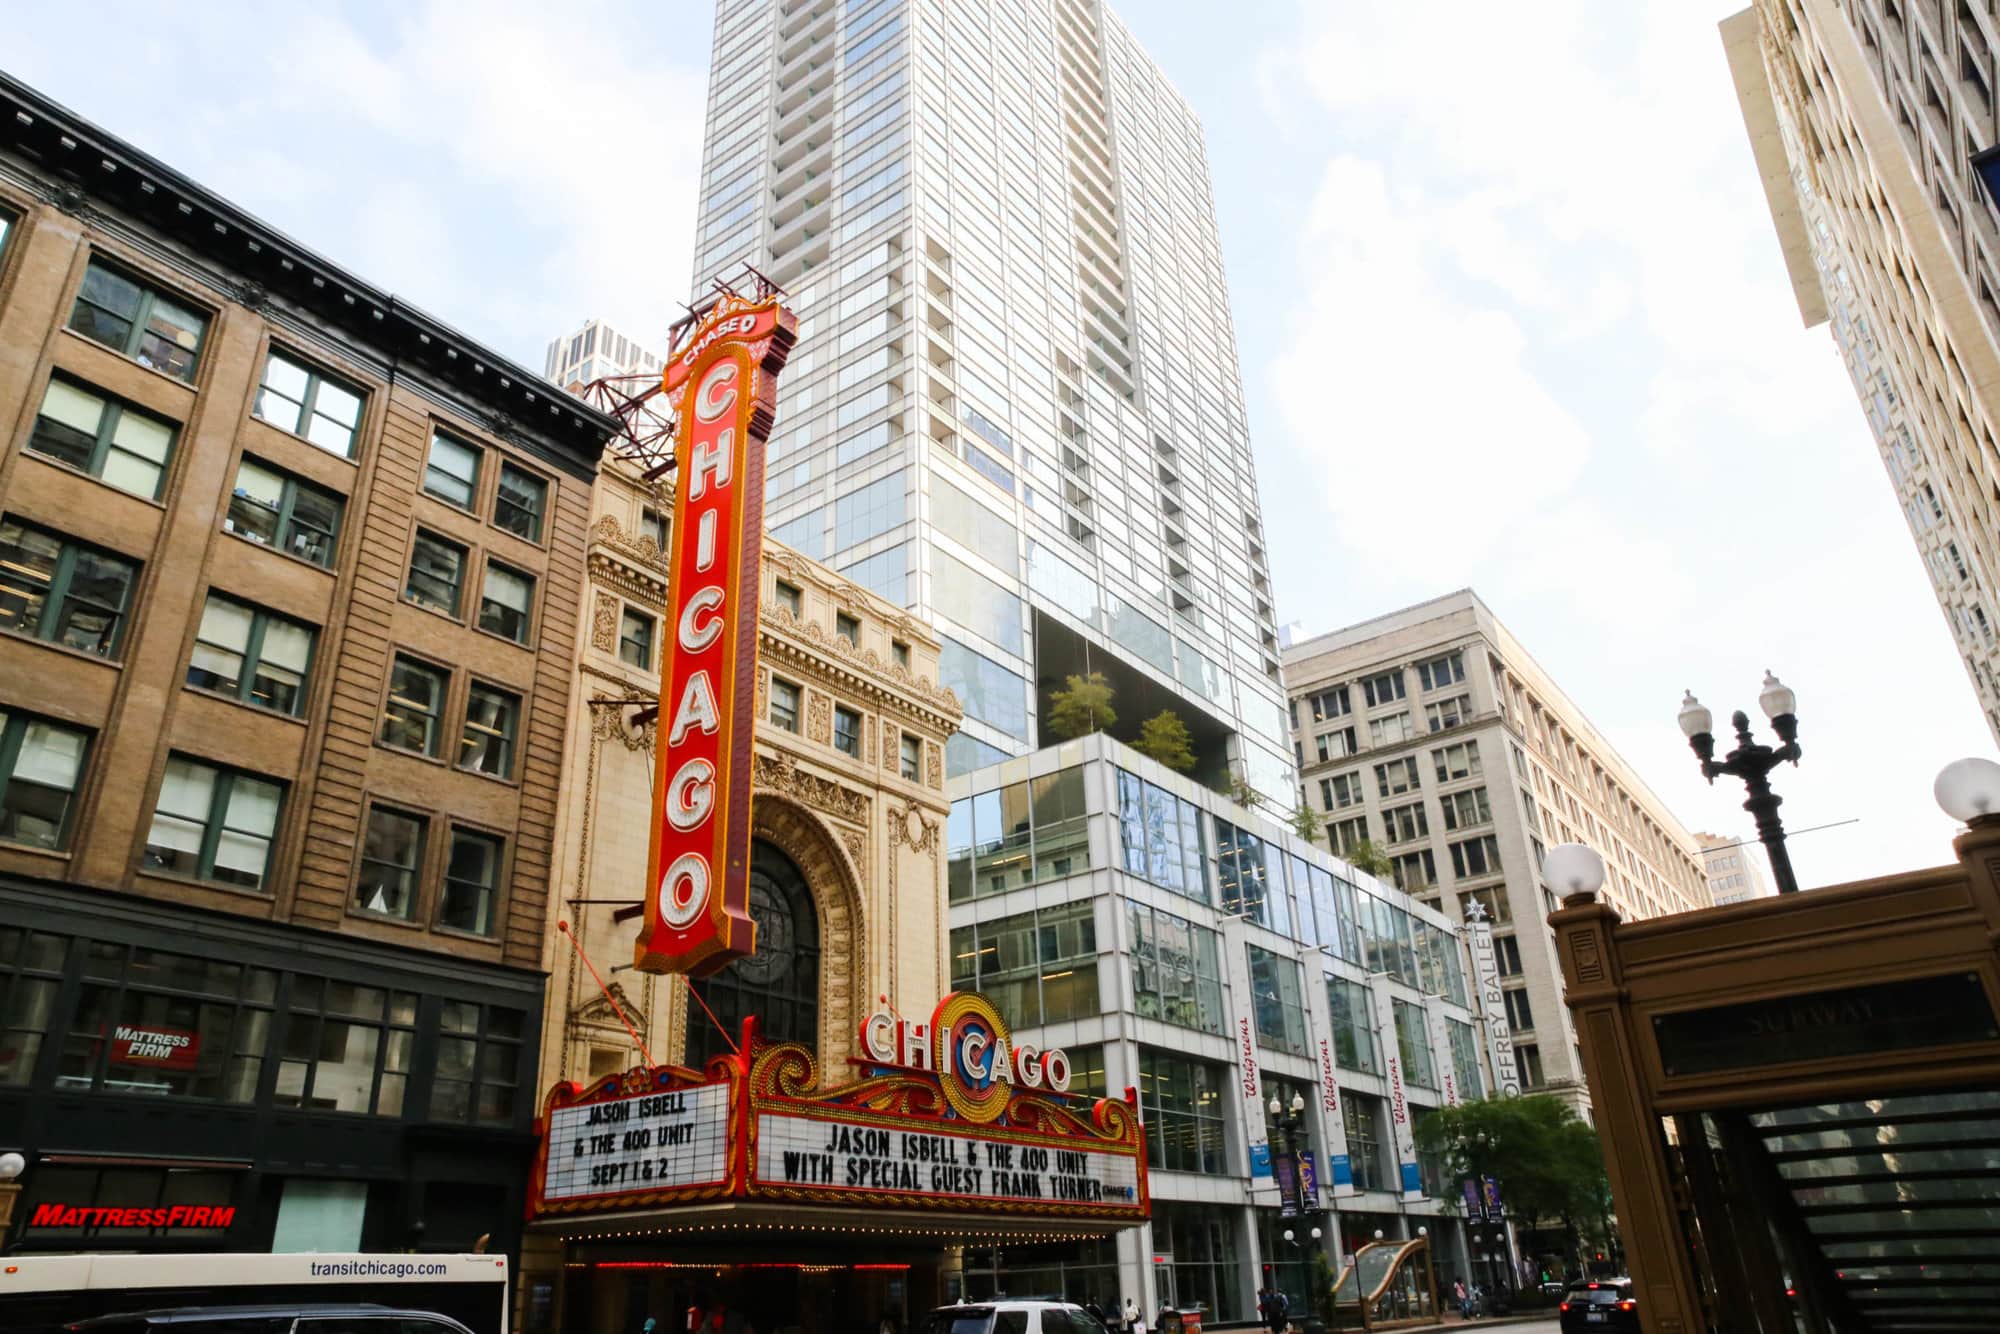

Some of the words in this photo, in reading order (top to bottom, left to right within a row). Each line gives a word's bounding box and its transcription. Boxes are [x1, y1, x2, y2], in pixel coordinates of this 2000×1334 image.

[683, 317, 739, 366] CHASE
[659, 362, 738, 931] CHICAGO
[1473, 925, 1502, 1004] BALLET
[128, 1042, 173, 1059] FIRM
[865, 1012, 1072, 1093] CHICAGO
[1238, 1016, 1257, 1099] Walgreens
[1319, 1038, 1338, 1113] Walgreens
[1491, 1013, 1520, 1099] OFFREY
[587, 1102, 630, 1126] JASON
[638, 1092, 687, 1118] ISBELL
[1388, 1057, 1406, 1125] Walgreens
[573, 1138, 584, 1158] &
[589, 1132, 616, 1155] THE
[622, 1128, 651, 1151] 400
[657, 1122, 695, 1147] UNIT
[825, 1124, 891, 1158] JASON
[901, 1133, 960, 1166] ISBELL
[966, 1142, 978, 1165] &
[985, 1142, 1015, 1170] THE
[1020, 1145, 1049, 1173] 400
[1056, 1149, 1089, 1176] UNIT
[591, 1164, 629, 1187] SEPT
[642, 1160, 653, 1180] &
[658, 1157, 669, 1179] 2
[783, 1151, 834, 1183] WITH
[846, 1157, 923, 1191] SPECIAL
[931, 1165, 983, 1195] GUEST
[991, 1171, 1043, 1199] FRANK
[1049, 1175, 1102, 1202] TURNER
[311, 1260, 447, 1278] transitchicago.com
